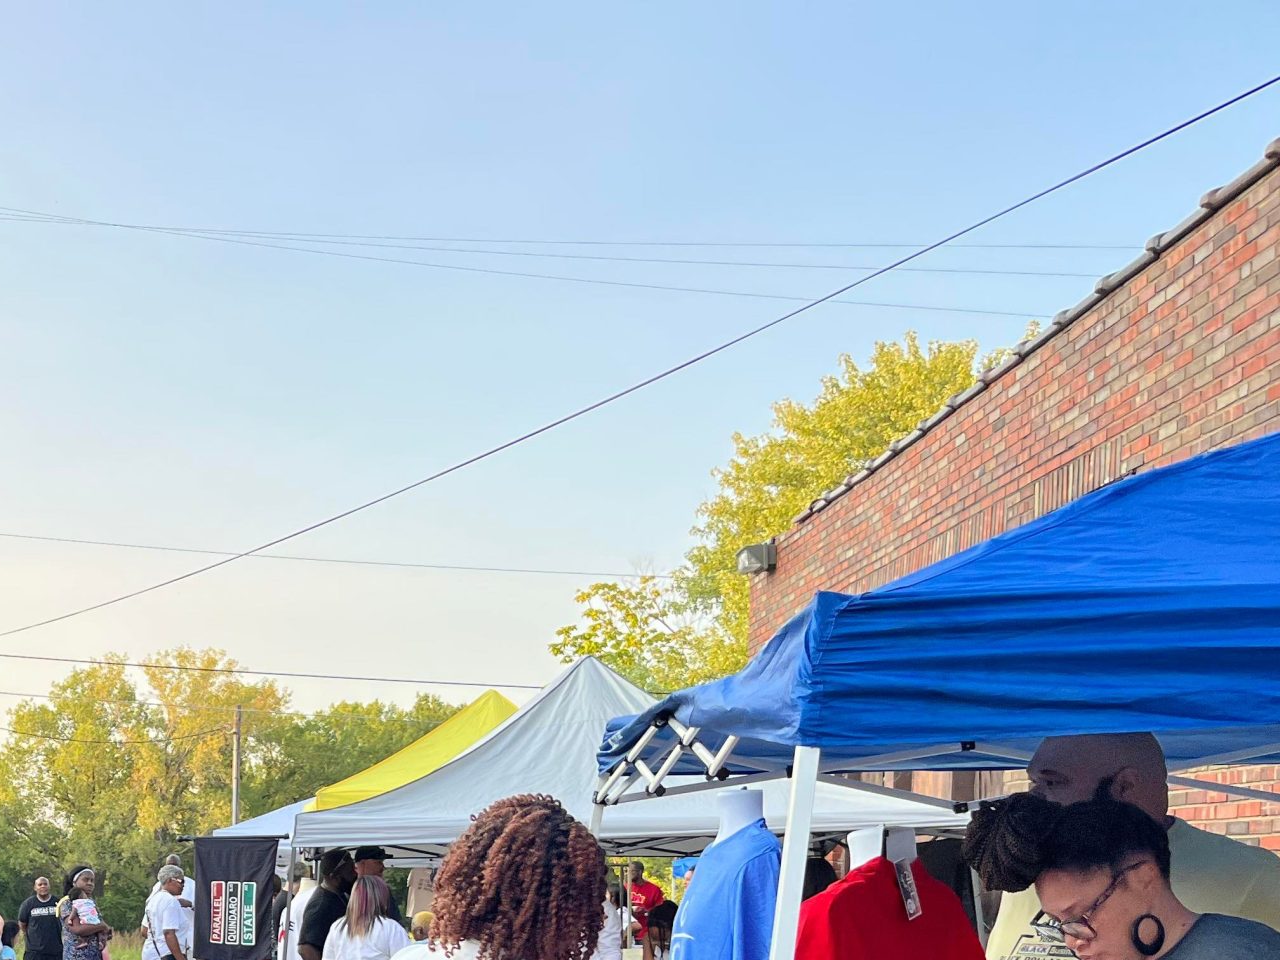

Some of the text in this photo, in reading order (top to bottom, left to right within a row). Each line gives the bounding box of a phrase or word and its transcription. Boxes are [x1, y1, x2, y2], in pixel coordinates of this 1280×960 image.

[212, 896, 222, 940] PARALLEL
[227, 896, 238, 942] QUINDARO
[243, 904, 253, 940] STATE
